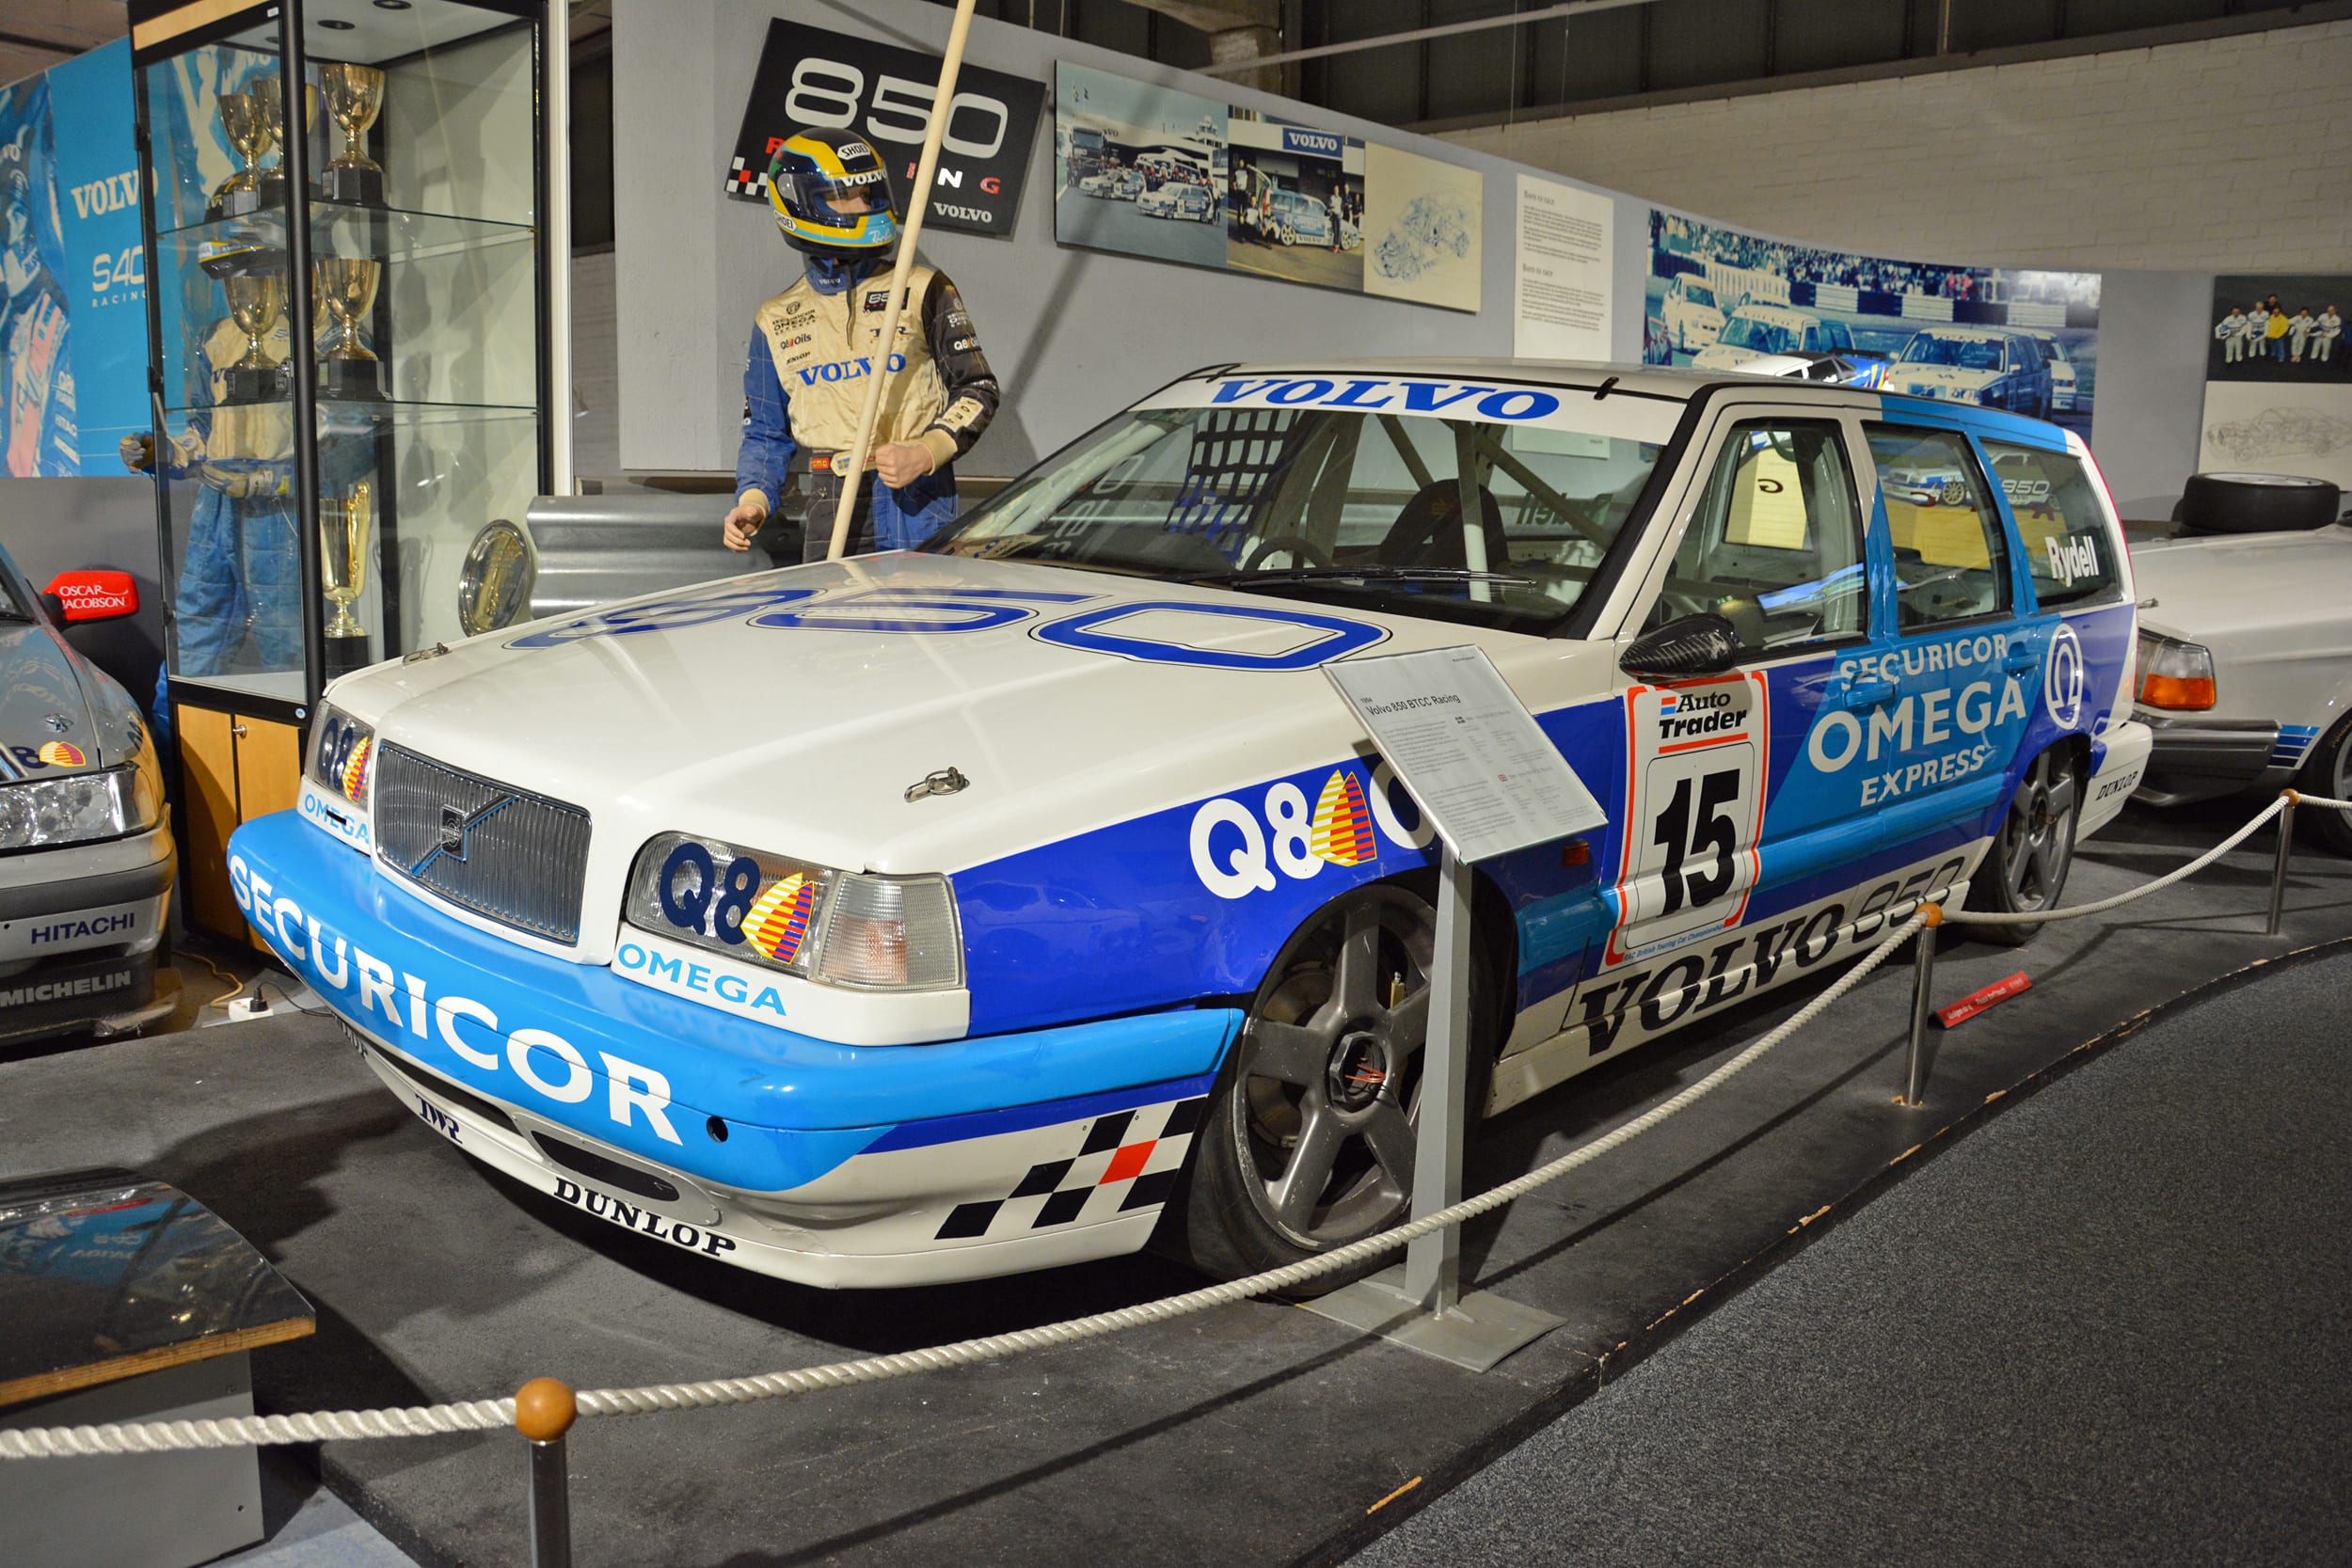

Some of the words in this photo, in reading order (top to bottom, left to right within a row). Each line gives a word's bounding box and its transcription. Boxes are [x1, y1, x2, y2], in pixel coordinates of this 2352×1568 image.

[785, 57, 1009, 159] 850
[841, 144, 870, 158] SHOEI
[1288, 132, 1338, 151] VOLVO
[933, 202, 993, 223] VOLVO
[868, 293, 889, 304] 85
[794, 333, 812, 345] Oils
[797, 353, 907, 387] VOLVO
[1212, 378, 1560, 420] VOLVO
[2044, 535, 2100, 588] Rydell
[59, 585, 129, 596] OSCAR
[1838, 633, 2010, 692] SECURICOR
[1365, 703, 1392, 716] Volvo
[1391, 701, 1408, 713] 850
[1407, 697, 1433, 710] BTCC
[1431, 693, 1462, 706] Racing
[1677, 689, 1732, 713] Auto
[1659, 708, 1748, 739] Trader
[1808, 678, 2027, 774] OMEGA
[1860, 745, 1986, 808] EXPRESS
[2094, 770, 2138, 801] DUNLOP
[1189, 782, 1326, 899] Q8
[1654, 768, 1741, 920] 15
[660, 842, 761, 945] Q8
[31, 912, 135, 944] HITACHI
[1579, 903, 1846, 1057] VOLVO
[1851, 856, 1965, 943] 850
[0, 970, 132, 1007] MICHELIN
[229, 853, 684, 1146] SECURICOR
[616, 942, 788, 1017] OMEGA
[415, 1092, 463, 1145] TWR
[553, 1176, 737, 1258] DUNLOP
